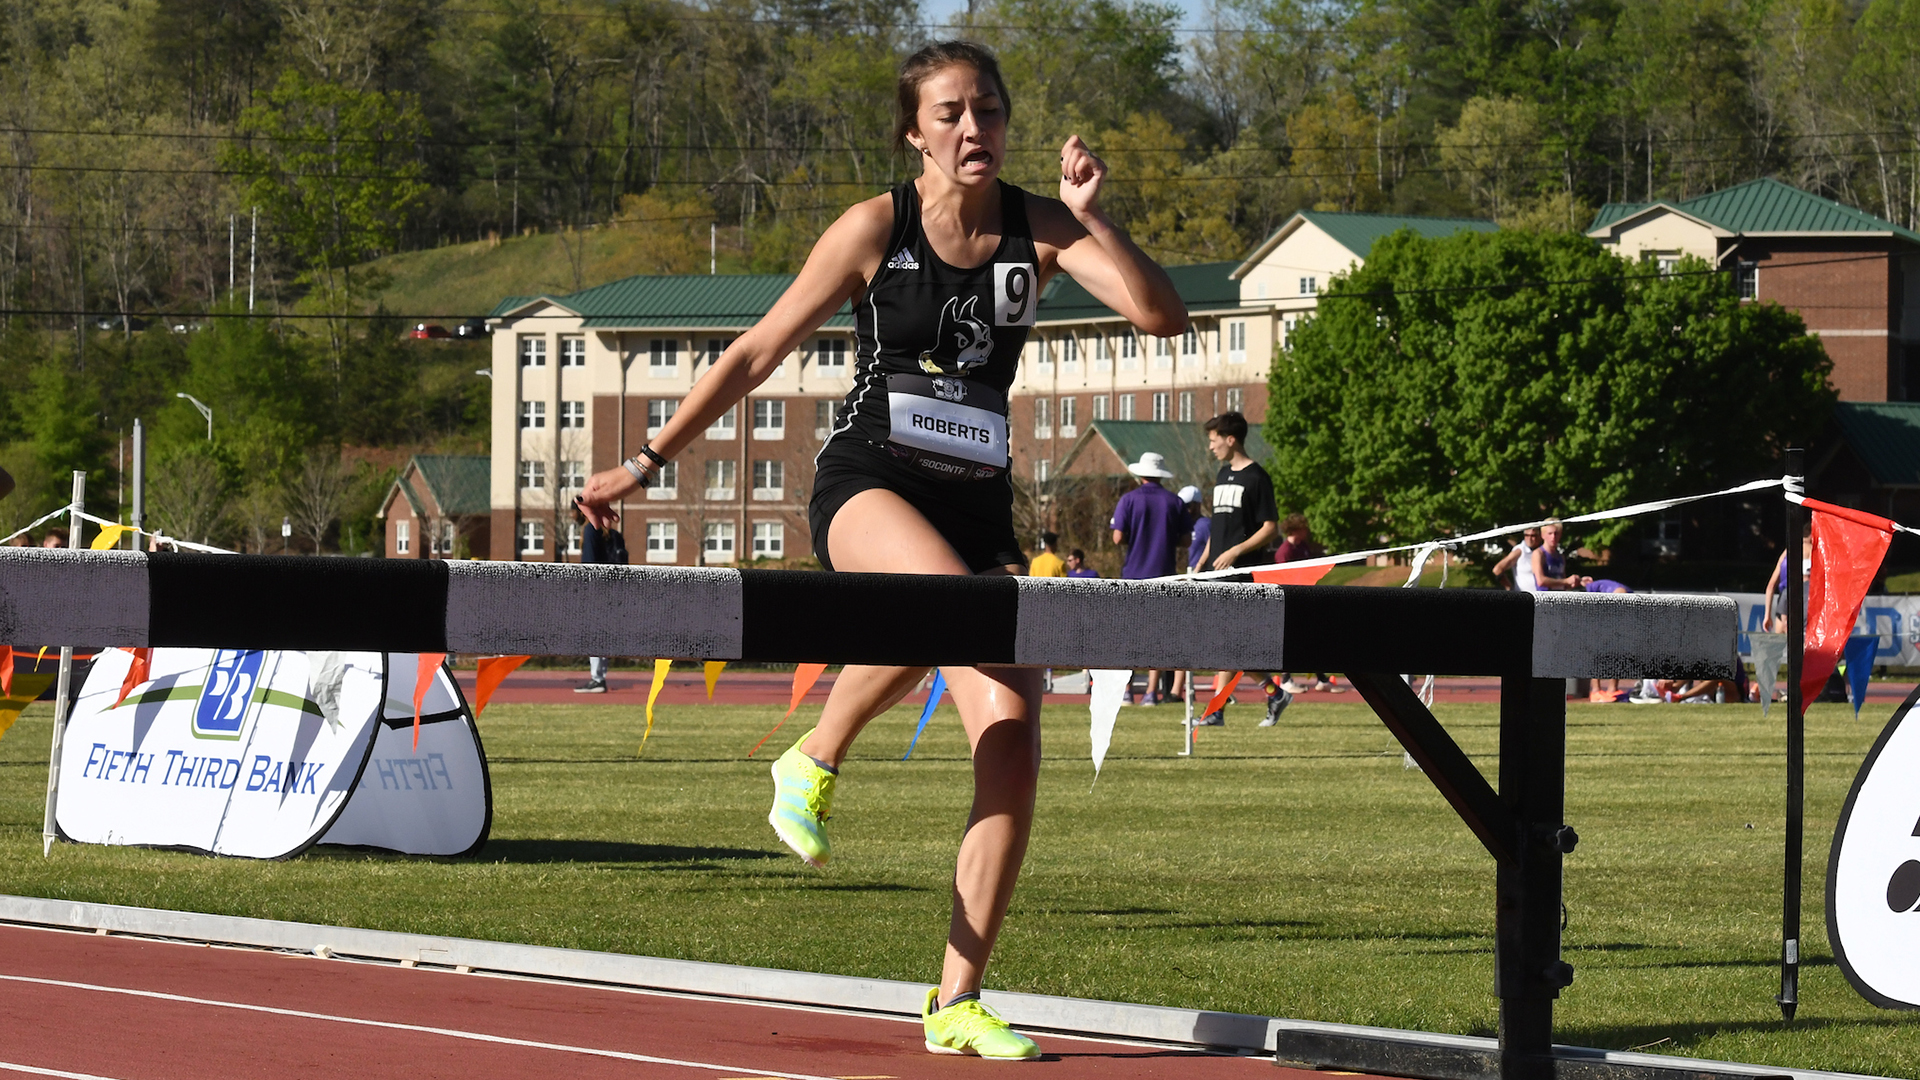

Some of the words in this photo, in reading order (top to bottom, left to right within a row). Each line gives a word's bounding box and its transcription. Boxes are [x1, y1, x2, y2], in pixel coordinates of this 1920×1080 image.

[887, 260, 920, 270] adidas
[1005, 266, 1030, 323] 9
[912, 413, 990, 444] ROBERTS
[83, 742, 155, 784] FIFTH
[162, 750, 241, 789] THIRD
[245, 755, 325, 794] BANK
